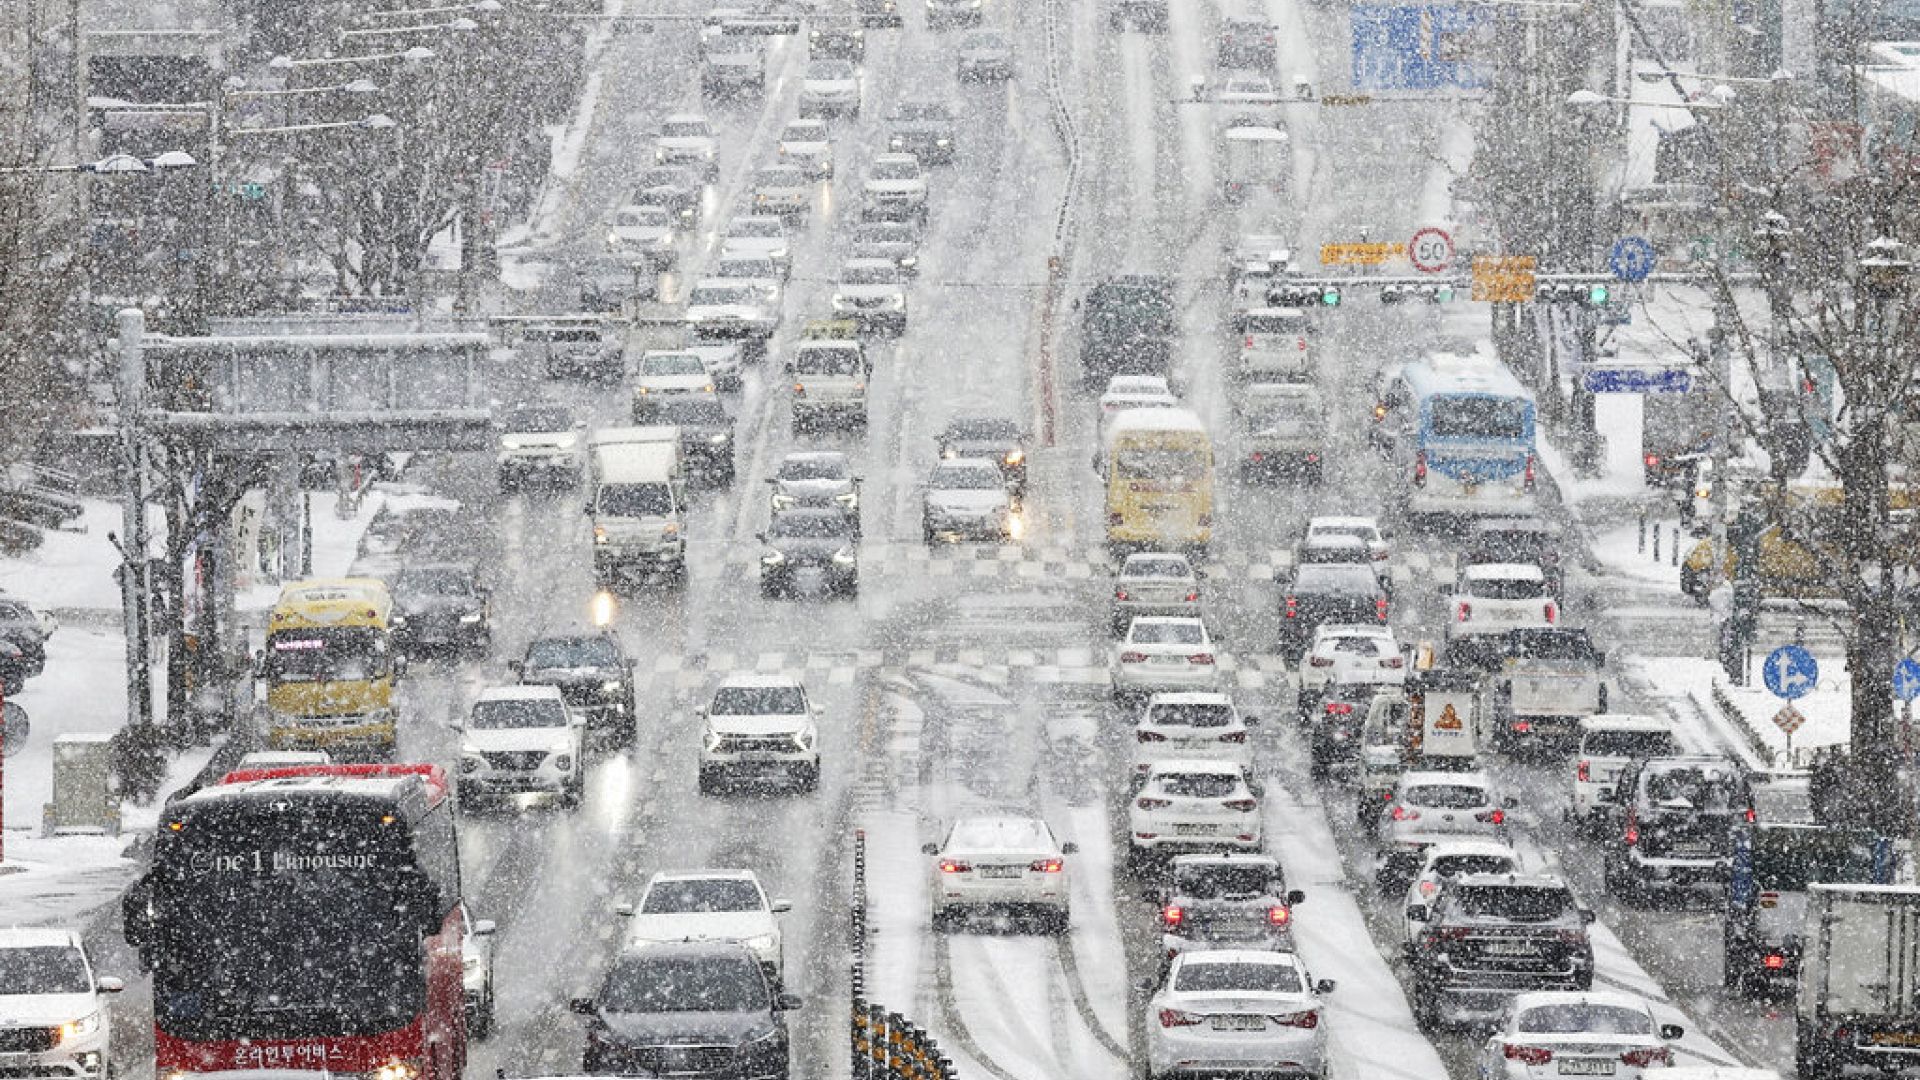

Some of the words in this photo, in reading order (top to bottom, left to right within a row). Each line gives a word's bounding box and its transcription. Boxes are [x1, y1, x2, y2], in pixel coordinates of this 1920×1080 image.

[190, 851, 245, 873] One
[273, 851, 378, 871] Limousine
[235, 1044, 344, 1065] 온라인투어버스
